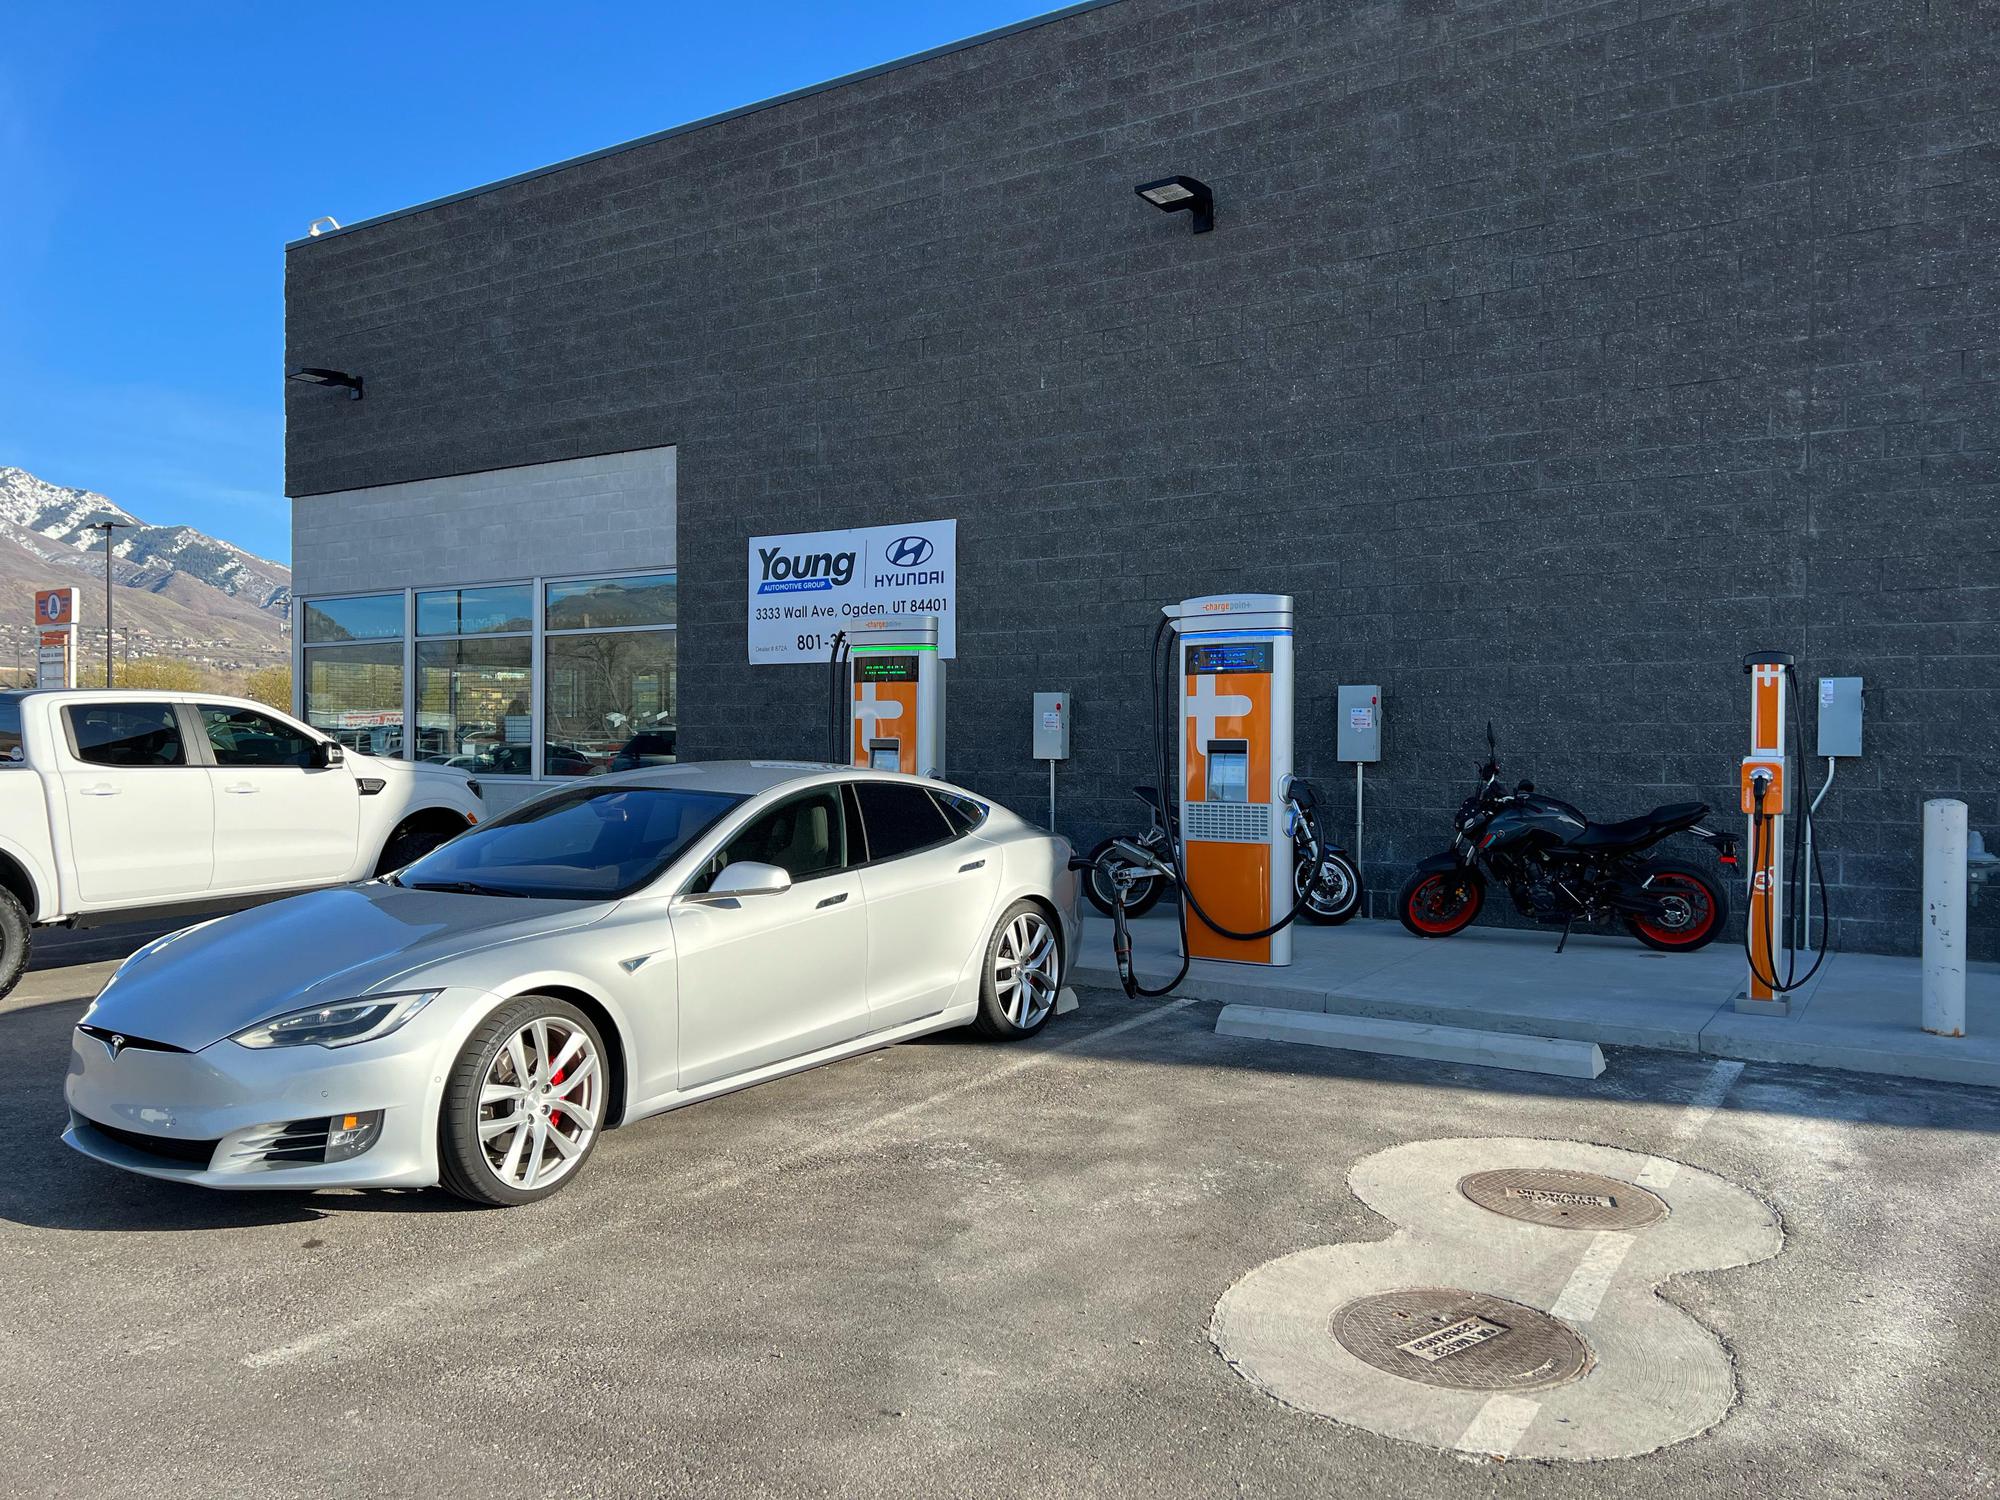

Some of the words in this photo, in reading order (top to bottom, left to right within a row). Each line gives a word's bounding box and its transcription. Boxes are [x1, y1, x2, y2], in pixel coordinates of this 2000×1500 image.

[758, 547, 856, 586] Young
[763, 582, 802, 592] AUTOMOTIVE
[803, 581, 826, 589] GROUP
[874, 570, 944, 588] HYUNDAI
[756, 607, 781, 621] 3333
[784, 605, 808, 619] Wall
[811, 605, 838, 618] Ave,
[893, 600, 906, 613] UT
[910, 598, 947, 613] 84401
